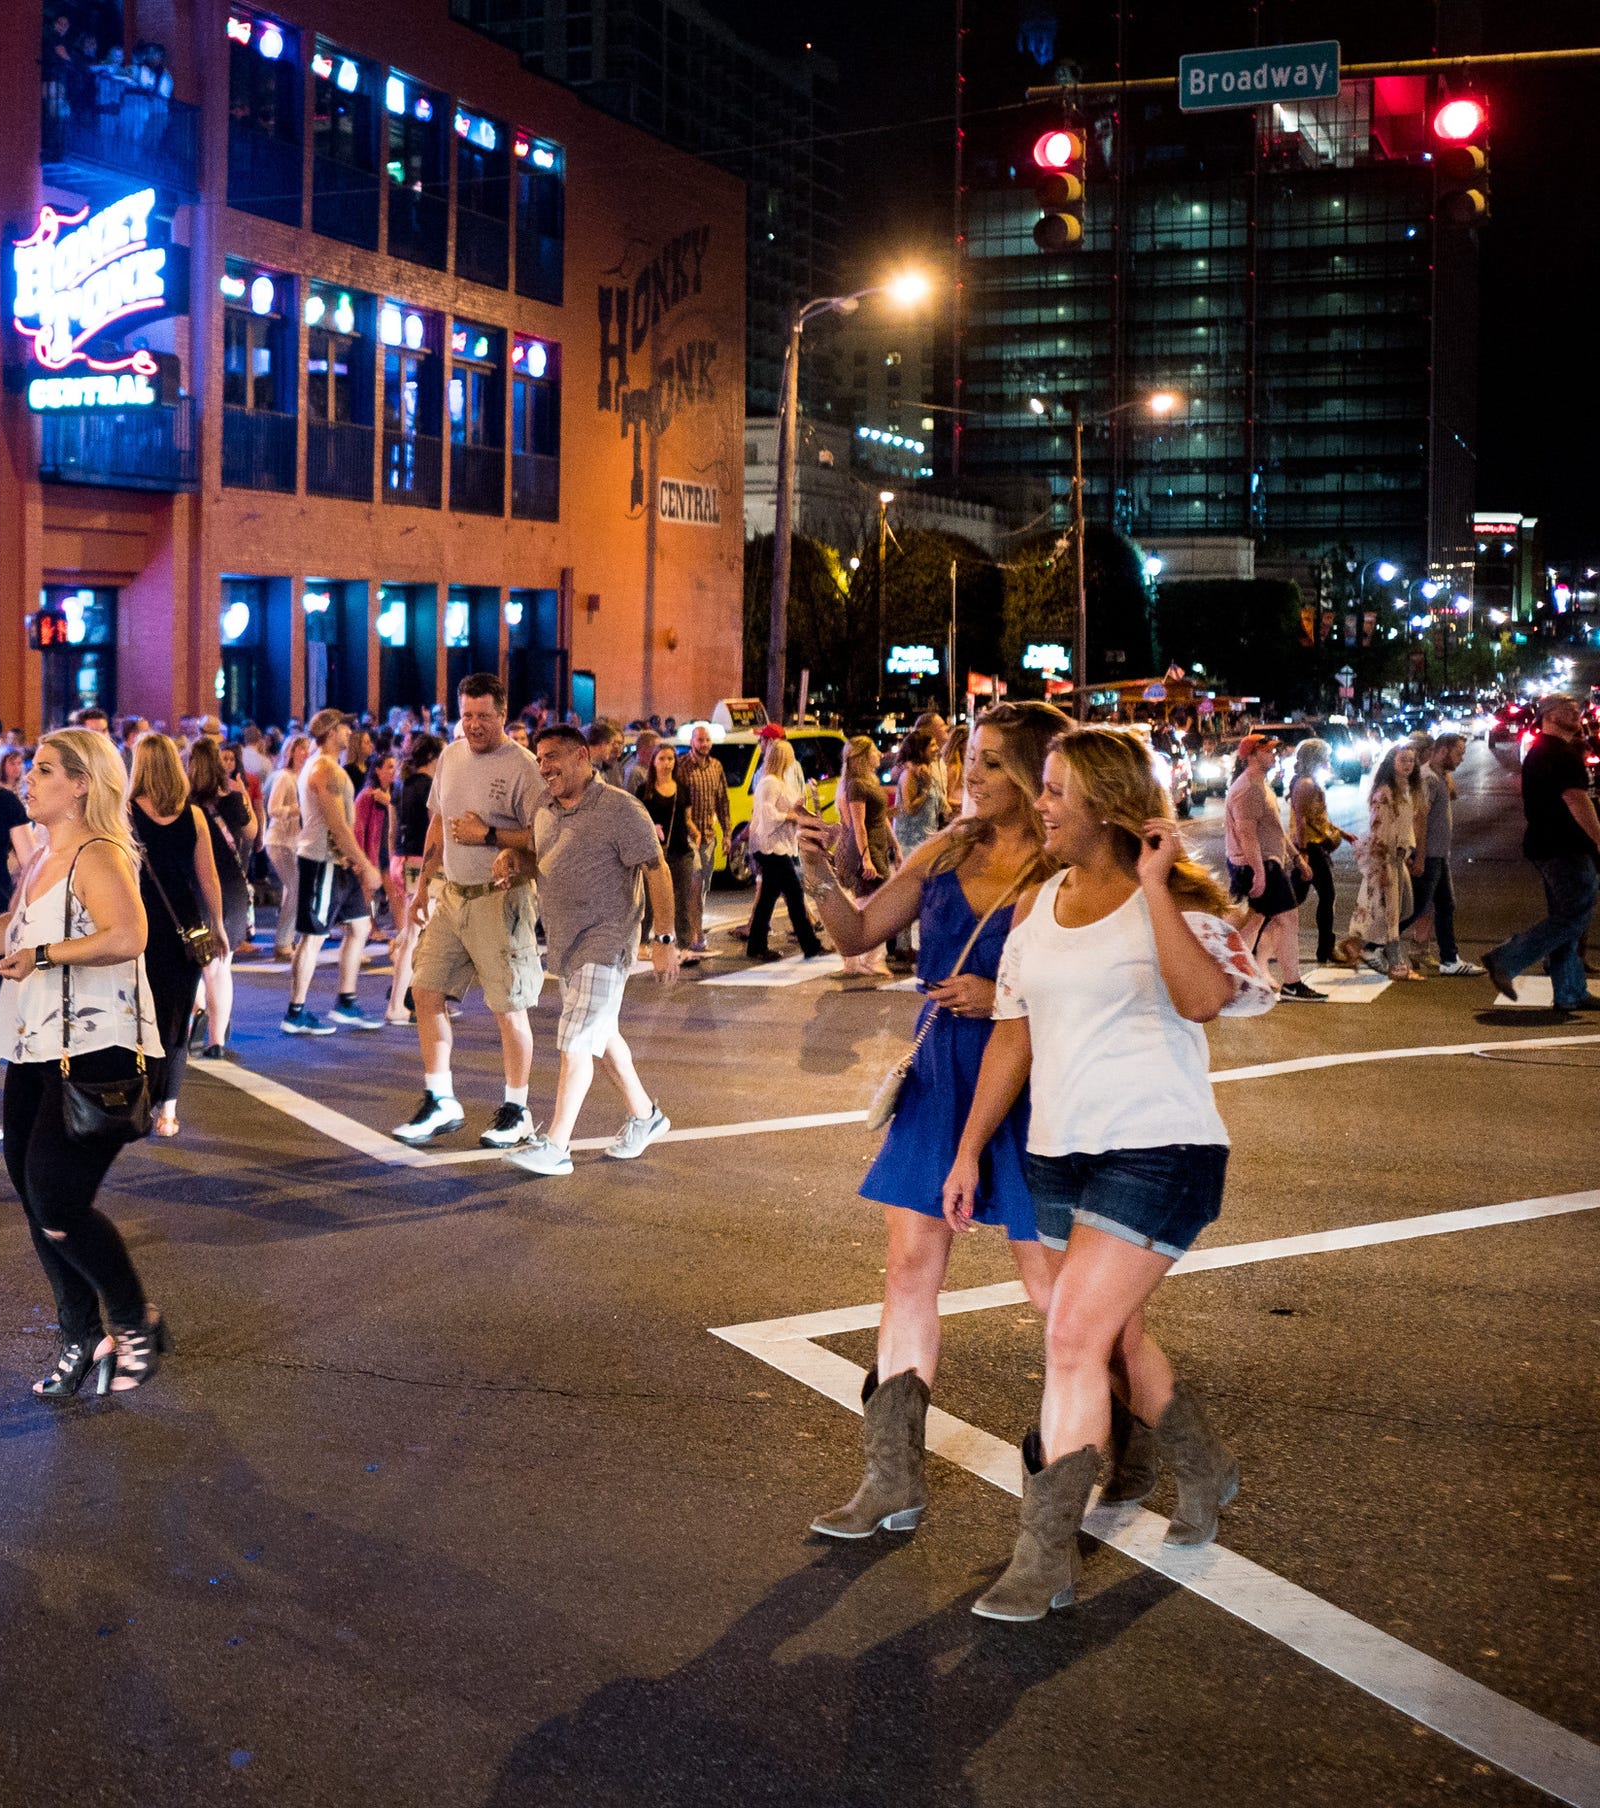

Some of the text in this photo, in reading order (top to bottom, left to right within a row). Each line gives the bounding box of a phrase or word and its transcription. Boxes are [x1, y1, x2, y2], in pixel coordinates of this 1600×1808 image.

[1189, 62, 1328, 95] Broadway
[597, 224, 711, 412] HONKY
[659, 480, 721, 523] CENTRAL
